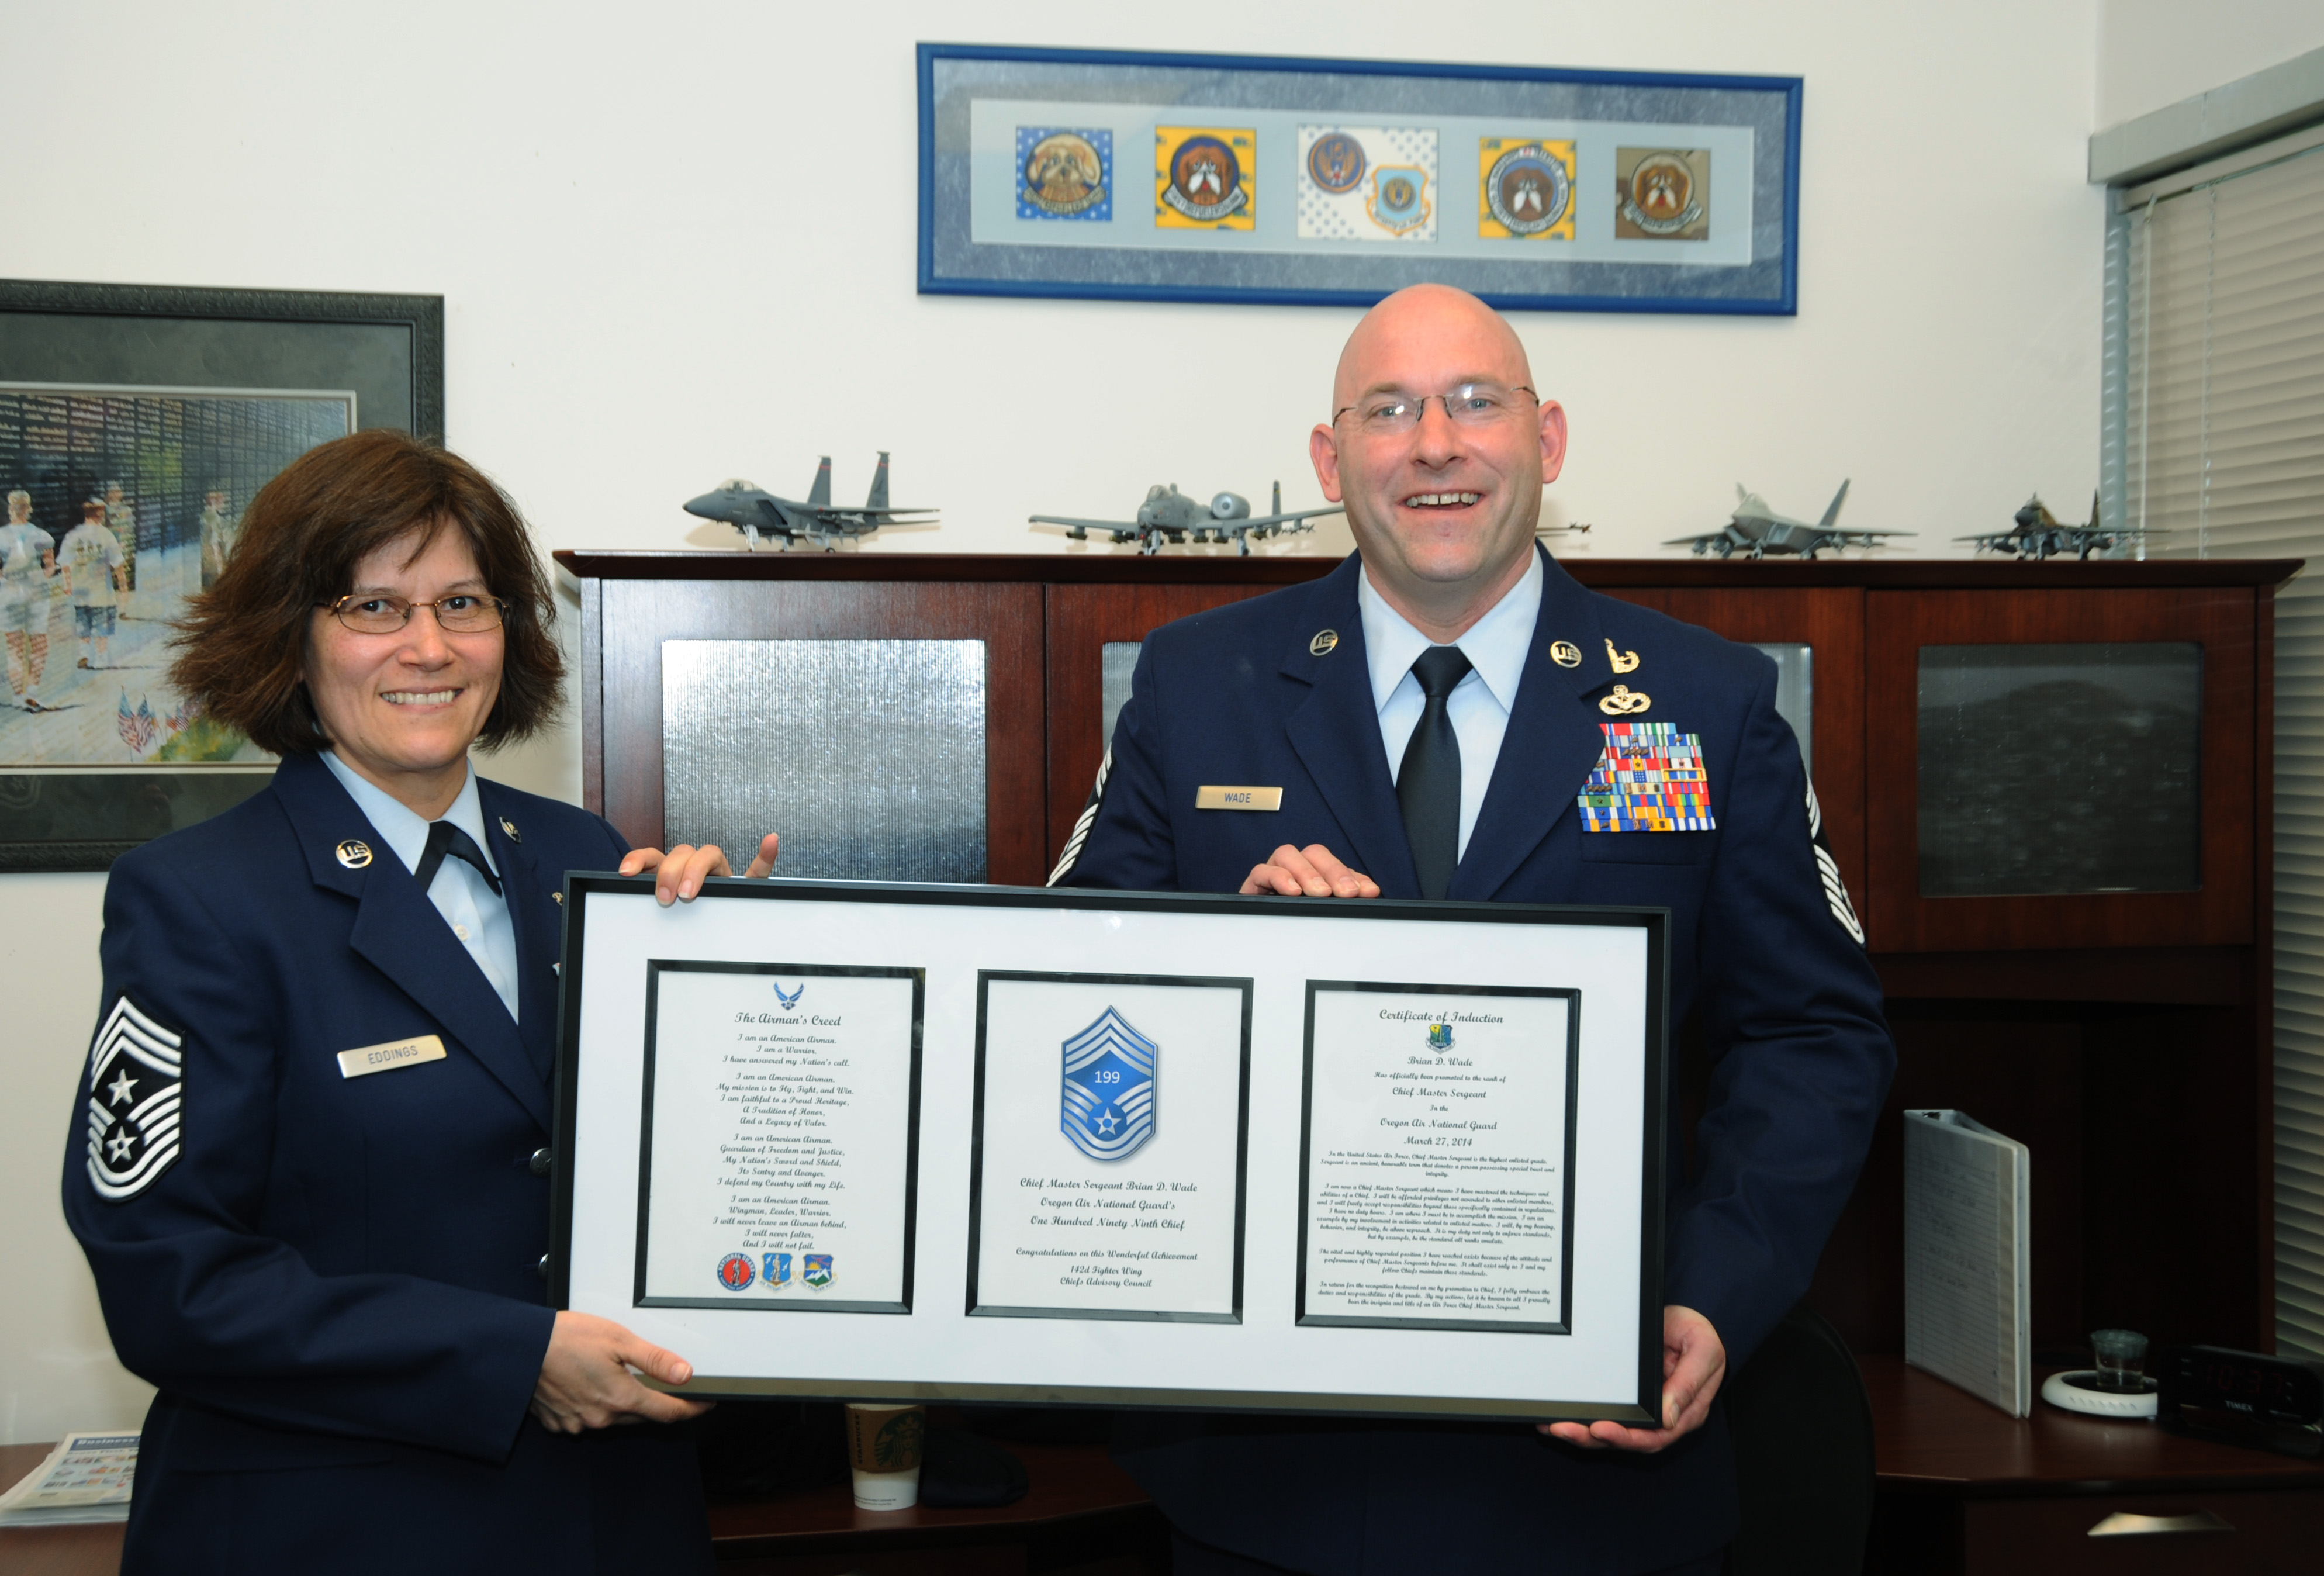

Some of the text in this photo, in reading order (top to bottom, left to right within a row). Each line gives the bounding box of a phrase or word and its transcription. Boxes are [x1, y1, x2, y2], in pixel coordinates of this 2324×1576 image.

[1225, 793, 1252, 803] WADE
[734, 1012, 841, 1026] The Airman's Creed
[1379, 1008, 1503, 1025] Certificate of Induction
[770, 1034, 805, 1042] American
[807, 1035, 836, 1044] Airman.
[367, 1045, 419, 1065] EDDINGS
[1407, 1056, 1473, 1066] Brian D. Wade
[799, 1057, 831, 1066] Nation's
[1094, 1070, 1120, 1084] 199
[1389, 1072, 1419, 1080] officially
[1499, 1076, 1506, 1084] of
[715, 1083, 730, 1092] My
[779, 1084, 794, 1094] Fly,
[797, 1085, 818, 1094] Fight,
[1392, 1086, 1486, 1100] Chief Master Sergeant
[741, 1094, 771, 1104] faithful
[788, 1096, 812, 1104] Proud
[814, 1097, 849, 1107] Heritage,
[752, 1106, 786, 1114] Tradition
[788, 1107, 797, 1117] of
[798, 1107, 825, 1117] Honor,
[765, 1118, 791, 1128] Legacy
[793, 1118, 802, 1128] of
[1379, 1117, 1498, 1132] Oregon Air National Guard
[1403, 1135, 1472, 1147] March 27, 2014
[720, 1144, 755, 1153] Guardian
[757, 1145, 766, 1155] of
[767, 1145, 799, 1154] Freedom
[818, 1147, 845, 1156] Justice,
[722, 1155, 737, 1165] My
[739, 1156, 771, 1164] Nation's
[773, 1157, 798, 1165] Sword
[815, 1159, 842, 1167] Shield,
[752, 1167, 776, 1177] Sentry
[794, 1169, 825, 1178] Avenger.
[1019, 1177, 1198, 1192] Chief Master Sergeant Brian D. Wade
[1040, 1197, 1175, 1212] Oregon Air National Guard's
[728, 1206, 831, 1216] Wingman, Leader, Warrior.
[758, 1218, 777, 1226] leave
[790, 1219, 818, 1227] Airman
[820, 1220, 846, 1229] behind,
[1030, 1215, 1185, 1232] One Hundred Ninety Ninth Chief
[1015, 1247, 1077, 1257] Congratulations
[1090, 1249, 1104, 1257] this
[1106, 1250, 1150, 1261] Wonderful
[1151, 1251, 1198, 1260] Achievement
[1070, 1265, 1142, 1277] 142d Fighter Wing
[1060, 1277, 1153, 1288] Chiefs Advisory Council
[2223, 1400, 2254, 1413] TIMEX
[855, 1413, 863, 1464] STARBUCKS
